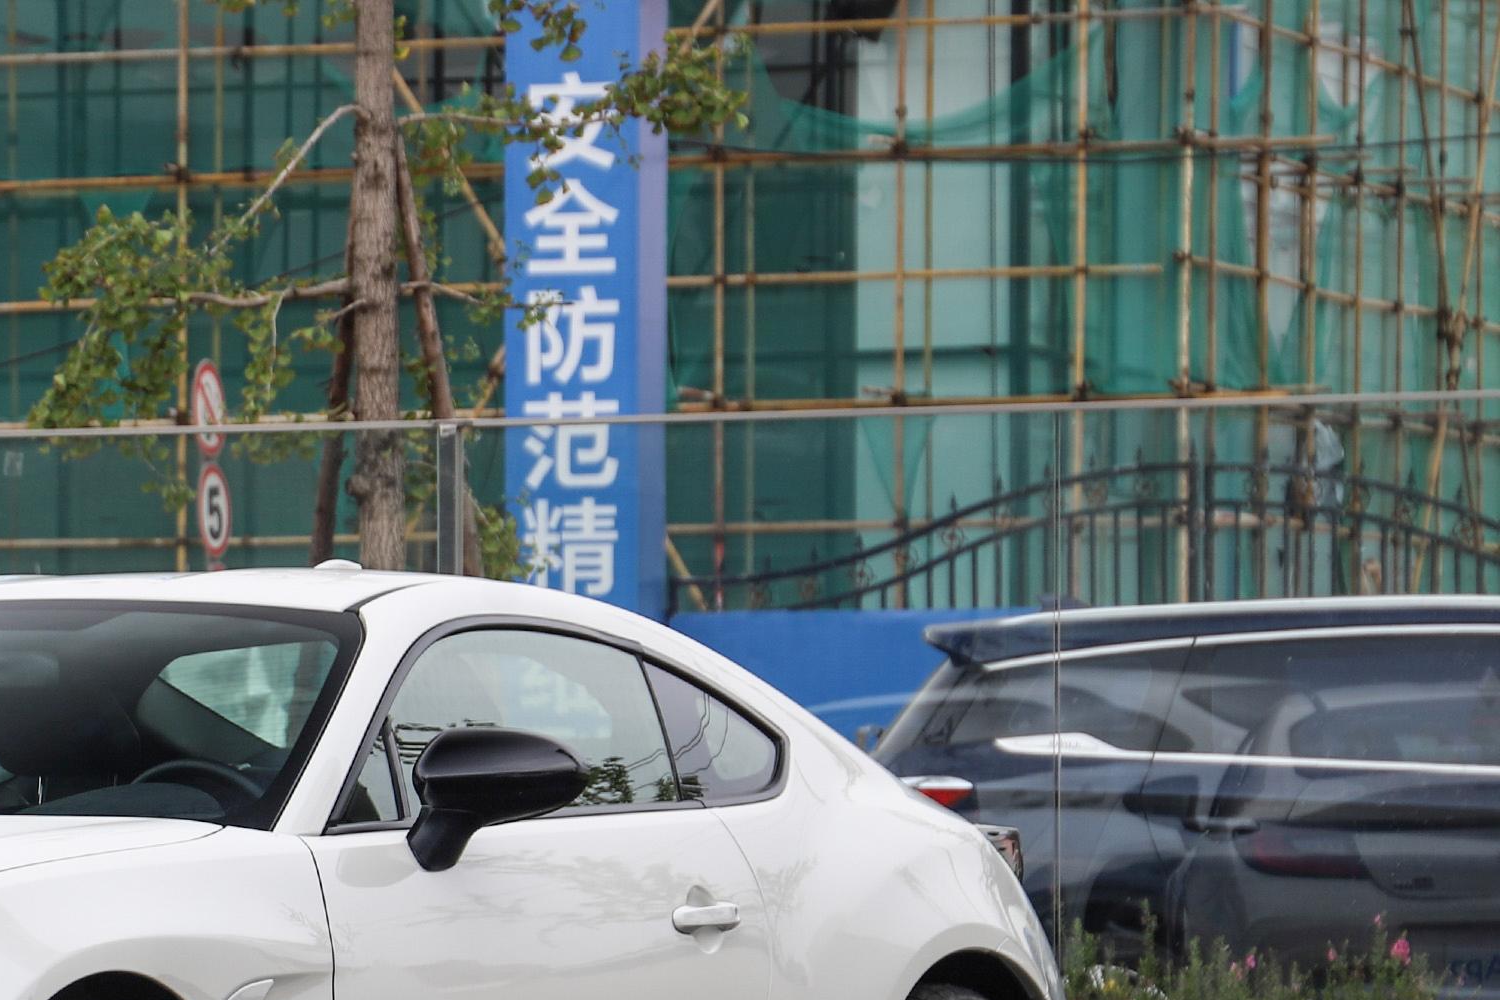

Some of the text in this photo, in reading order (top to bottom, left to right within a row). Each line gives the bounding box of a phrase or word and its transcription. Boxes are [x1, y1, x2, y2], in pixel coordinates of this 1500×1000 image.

[524, 71, 620, 597] 安全防范精
[207, 485, 222, 540] 5
